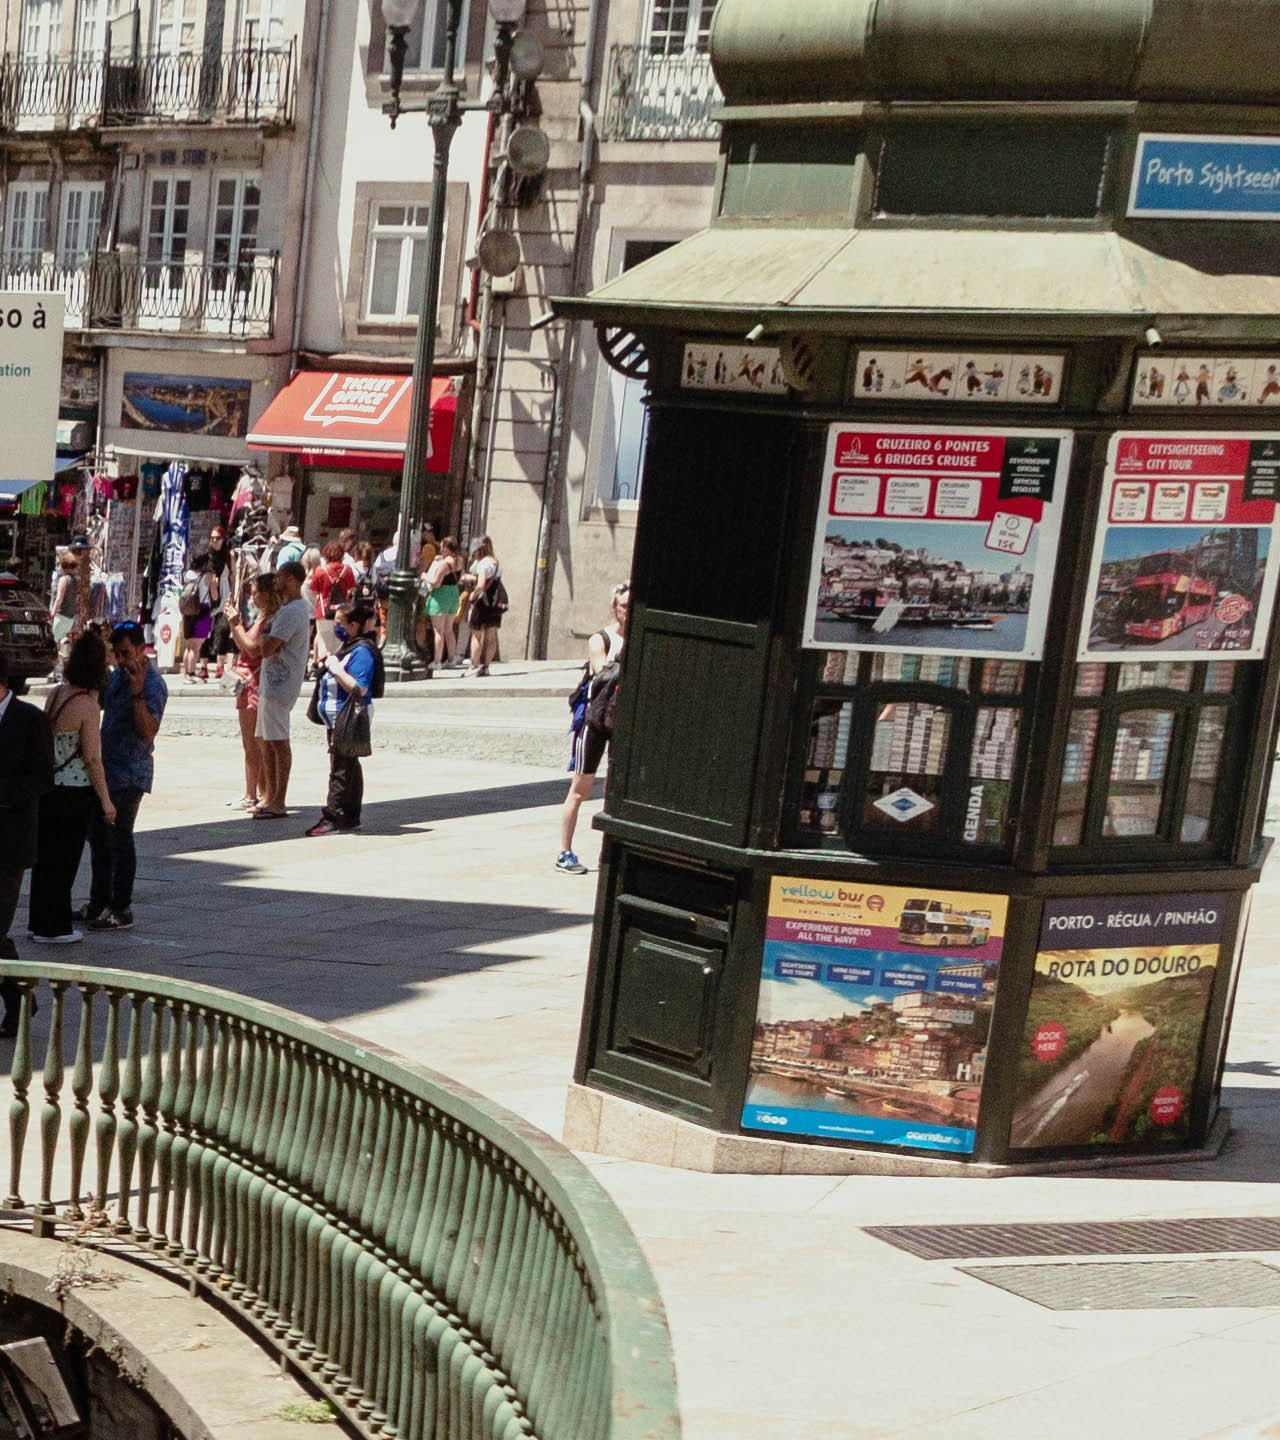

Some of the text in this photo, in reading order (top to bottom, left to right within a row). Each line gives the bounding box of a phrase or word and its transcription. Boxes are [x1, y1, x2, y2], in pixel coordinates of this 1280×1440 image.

[1146, 158, 1193, 186] Porto
[32, 302, 46, 329] à
[342, 377, 395, 392] TICKET
[332, 391, 389, 405] OFFICE
[876, 438, 990, 453] CRUZEIRO 6 PONTES
[1148, 444, 1224, 456] CITYSIGHTSEEING
[874, 453, 977, 467] 6 BRIDGES CRUISE
[1146, 459, 1193, 471] CITY TOUR
[964, 784, 985, 842] GENDA
[838, 888, 864, 902] bus
[1048, 916, 1094, 930] PORTO
[1107, 912, 1151, 928] RÉGUA
[1164, 908, 1217, 925] PINHÃO
[786, 921, 871, 936] EXPERIENCE PORTO
[798, 932, 856, 945] ALL THE WAY!
[1048, 955, 1200, 978] ROTA DO DOURO
[1037, 1031, 1061, 1041] BOOK
[1037, 1042, 1057, 1052] HERE
